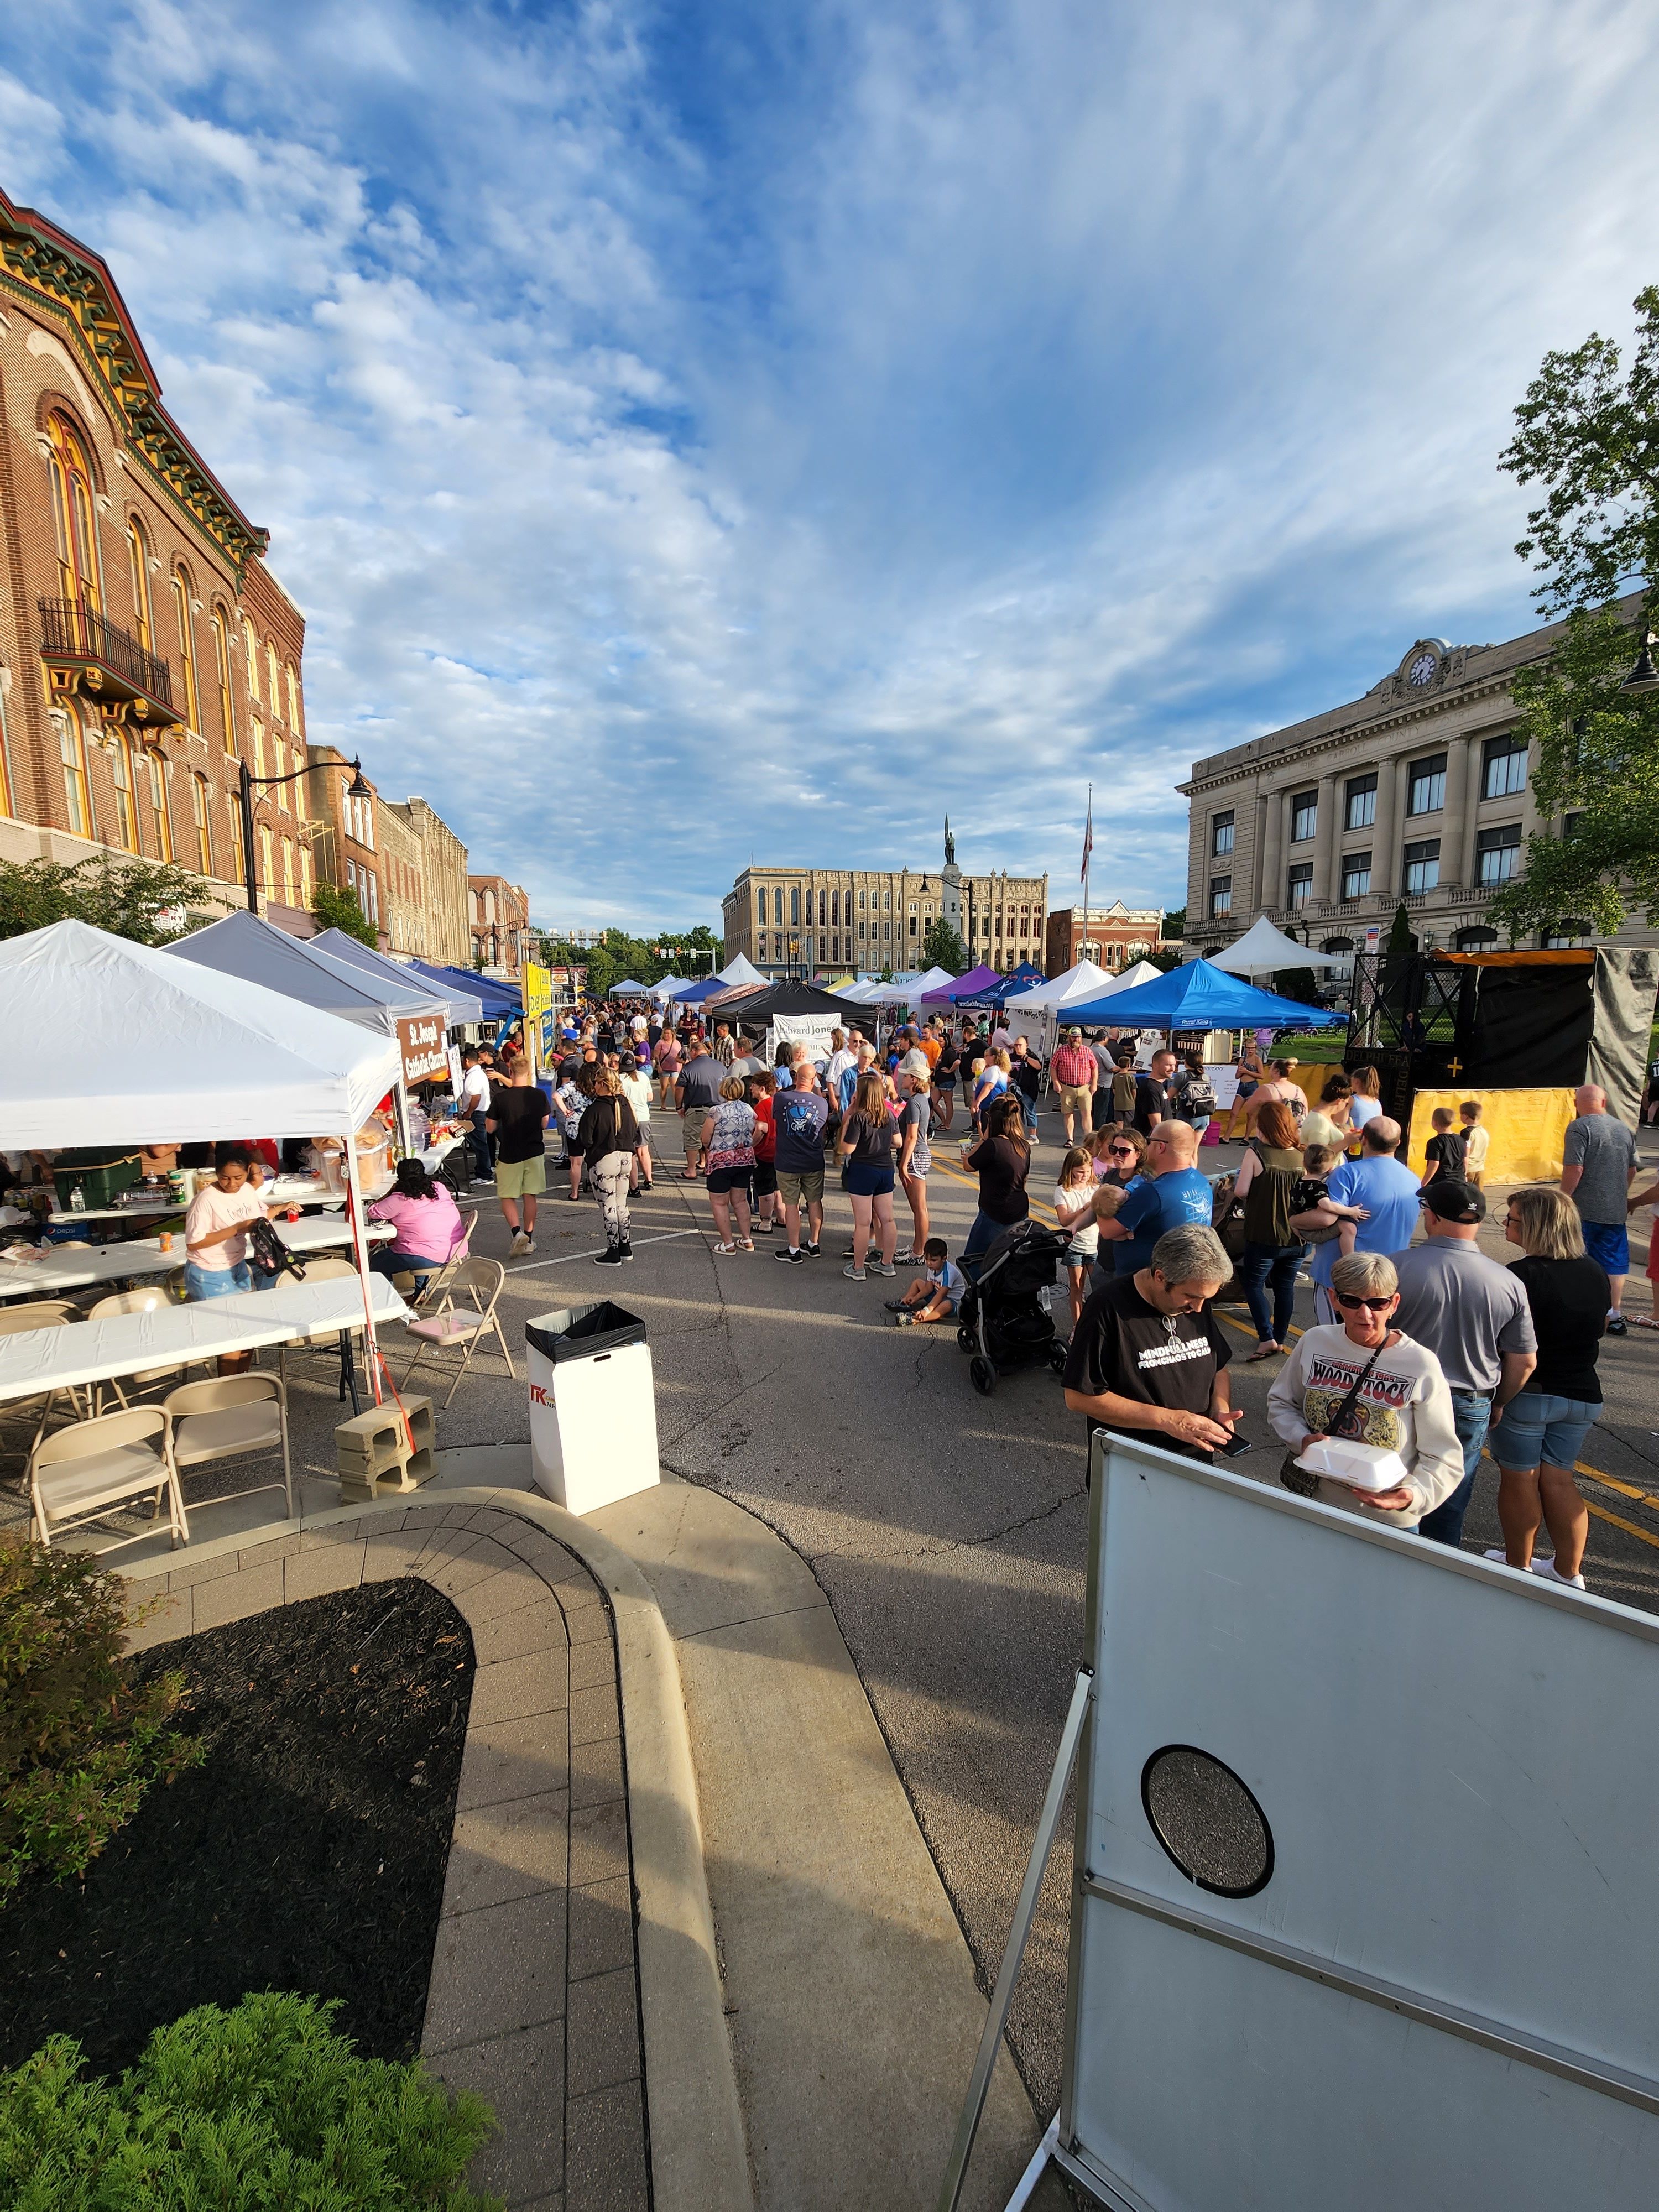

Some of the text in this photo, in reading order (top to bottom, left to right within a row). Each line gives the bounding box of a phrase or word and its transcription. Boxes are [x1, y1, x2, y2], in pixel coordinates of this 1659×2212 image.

[409, 1021, 438, 1046] St. Joseph
[405, 1053, 430, 1080] Catholic
[428, 1050, 447, 1071] Church
[1389, 1054, 1409, 1067] FFA
[1161, 1353, 1187, 1365] CHAOS
[1185, 1350, 1197, 1359] TO
